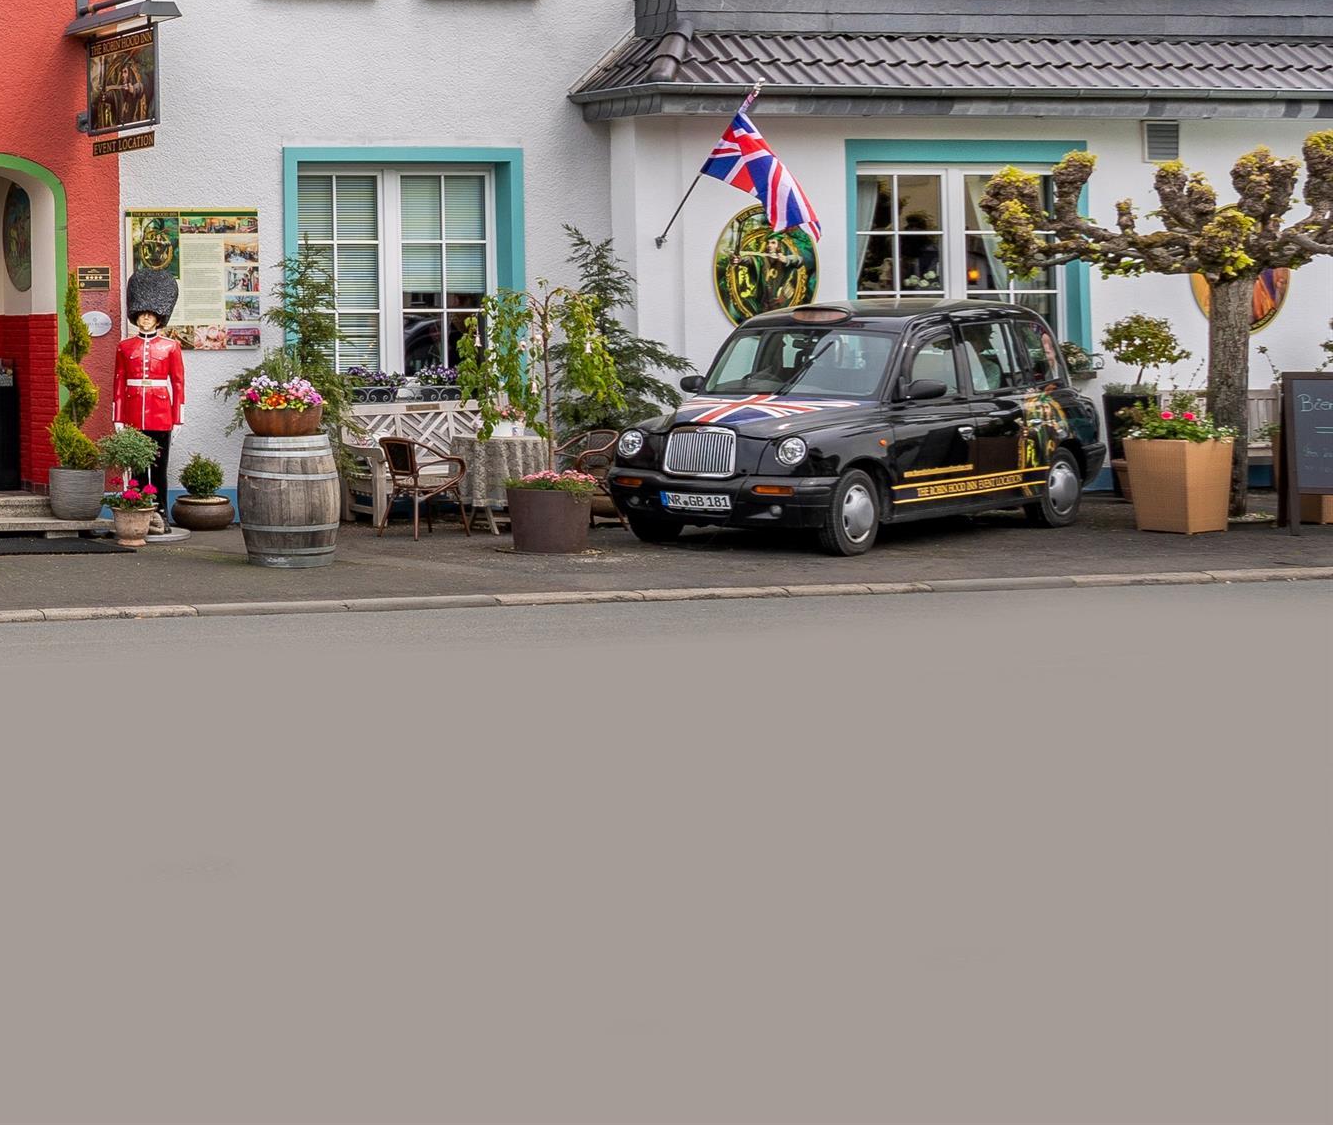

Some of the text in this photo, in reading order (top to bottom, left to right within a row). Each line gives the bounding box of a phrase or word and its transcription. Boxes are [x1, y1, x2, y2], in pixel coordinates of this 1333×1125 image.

[91, 30, 153, 56] THE ROBIN HOOD INN
[94, 134, 154, 155] EVENT LOCATION
[917, 487, 929, 497] THE
[949, 482, 966, 493] HOOD
[668, 495, 730, 508] NR GB 181
